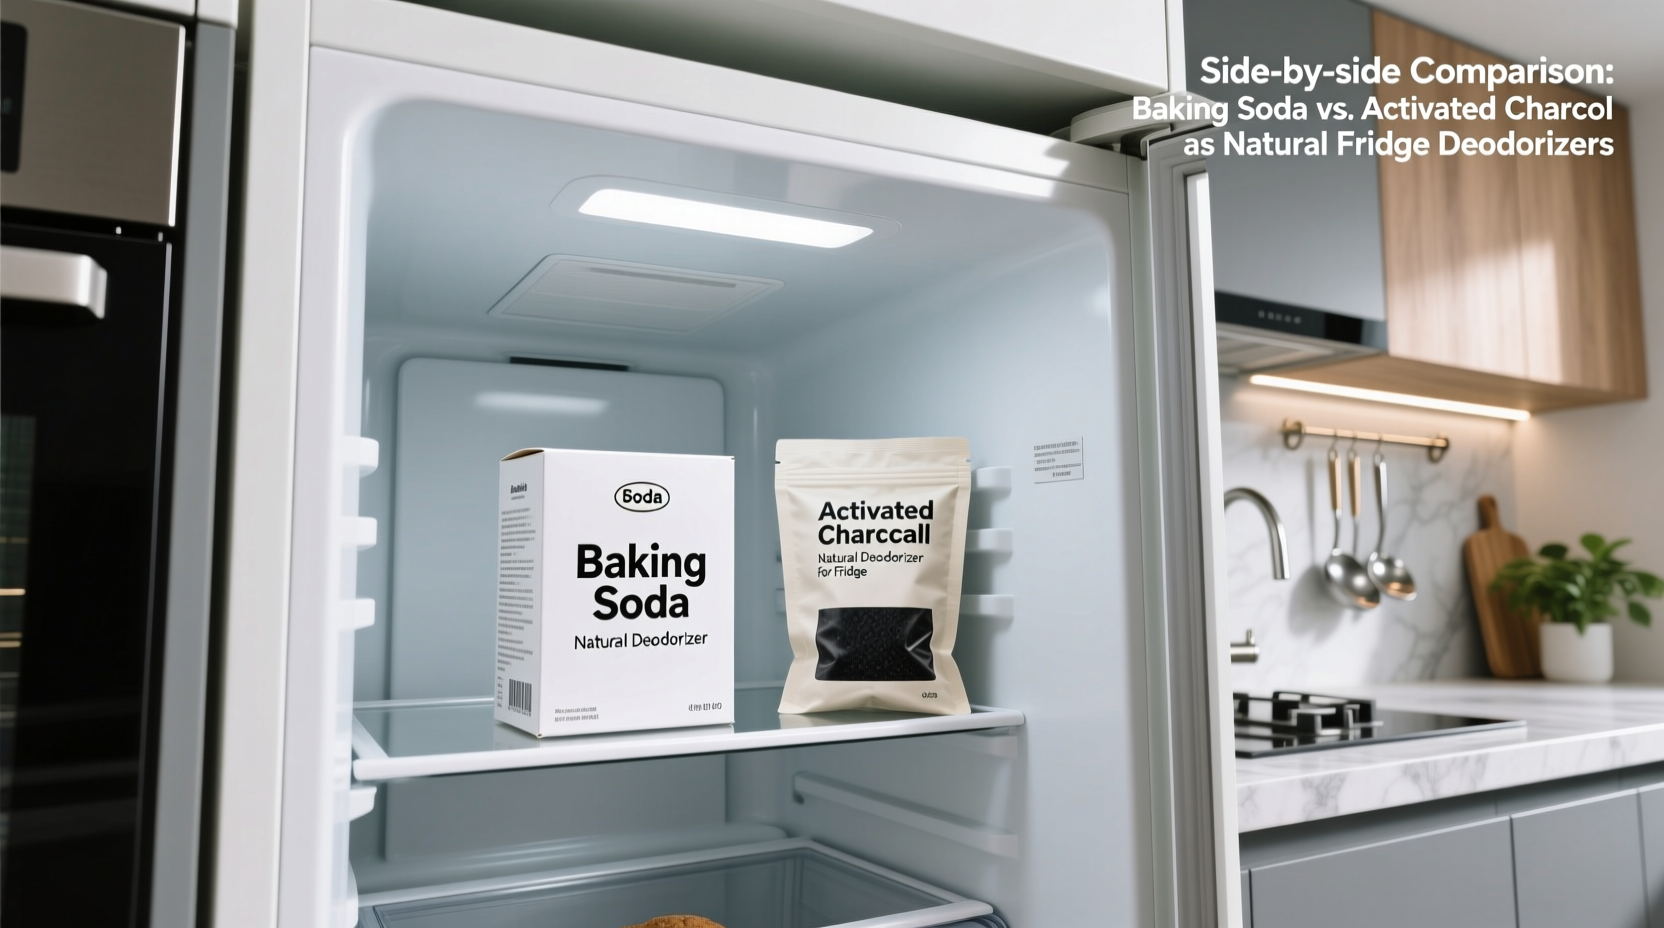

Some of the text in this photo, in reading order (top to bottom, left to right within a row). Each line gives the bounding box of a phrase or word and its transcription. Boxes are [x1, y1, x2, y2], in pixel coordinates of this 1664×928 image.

[818, 499, 934, 521] Activated
[818, 523, 931, 545] Charccall
[576, 541, 706, 588] Baking
[818, 550, 924, 564] Natural Deodorizer
[592, 584, 689, 621] Soda
[574, 633, 627, 650] Natural
